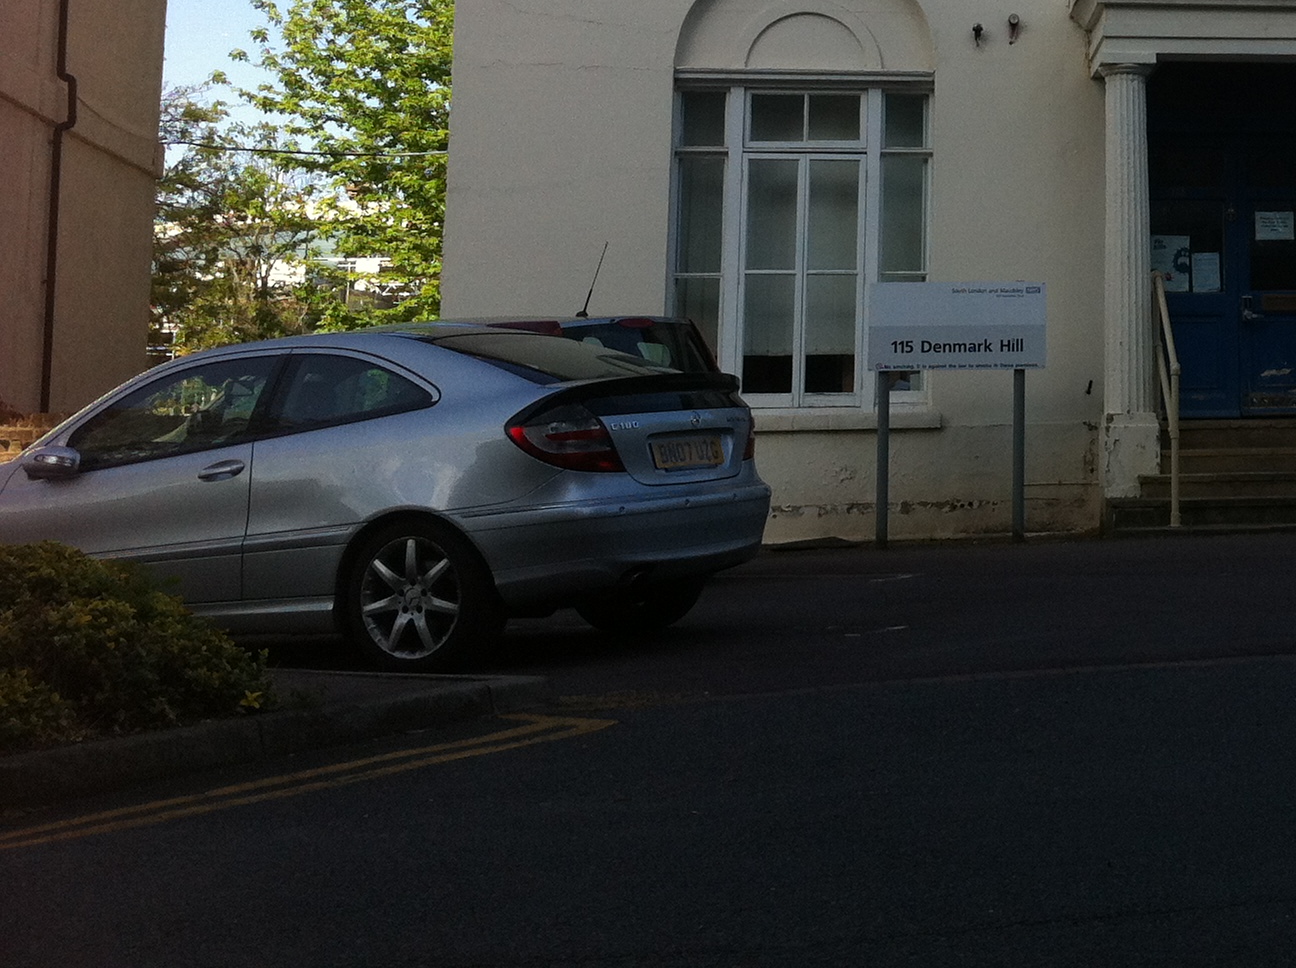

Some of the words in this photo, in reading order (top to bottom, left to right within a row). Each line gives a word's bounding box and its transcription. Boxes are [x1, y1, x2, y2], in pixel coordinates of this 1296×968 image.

[951, 287, 967, 295] South
[967, 287, 987, 295] London
[988, 287, 999, 295] and
[891, 340, 914, 354] 115
[920, 338, 993, 354] Denmark
[1000, 338, 1024, 353] Hill
